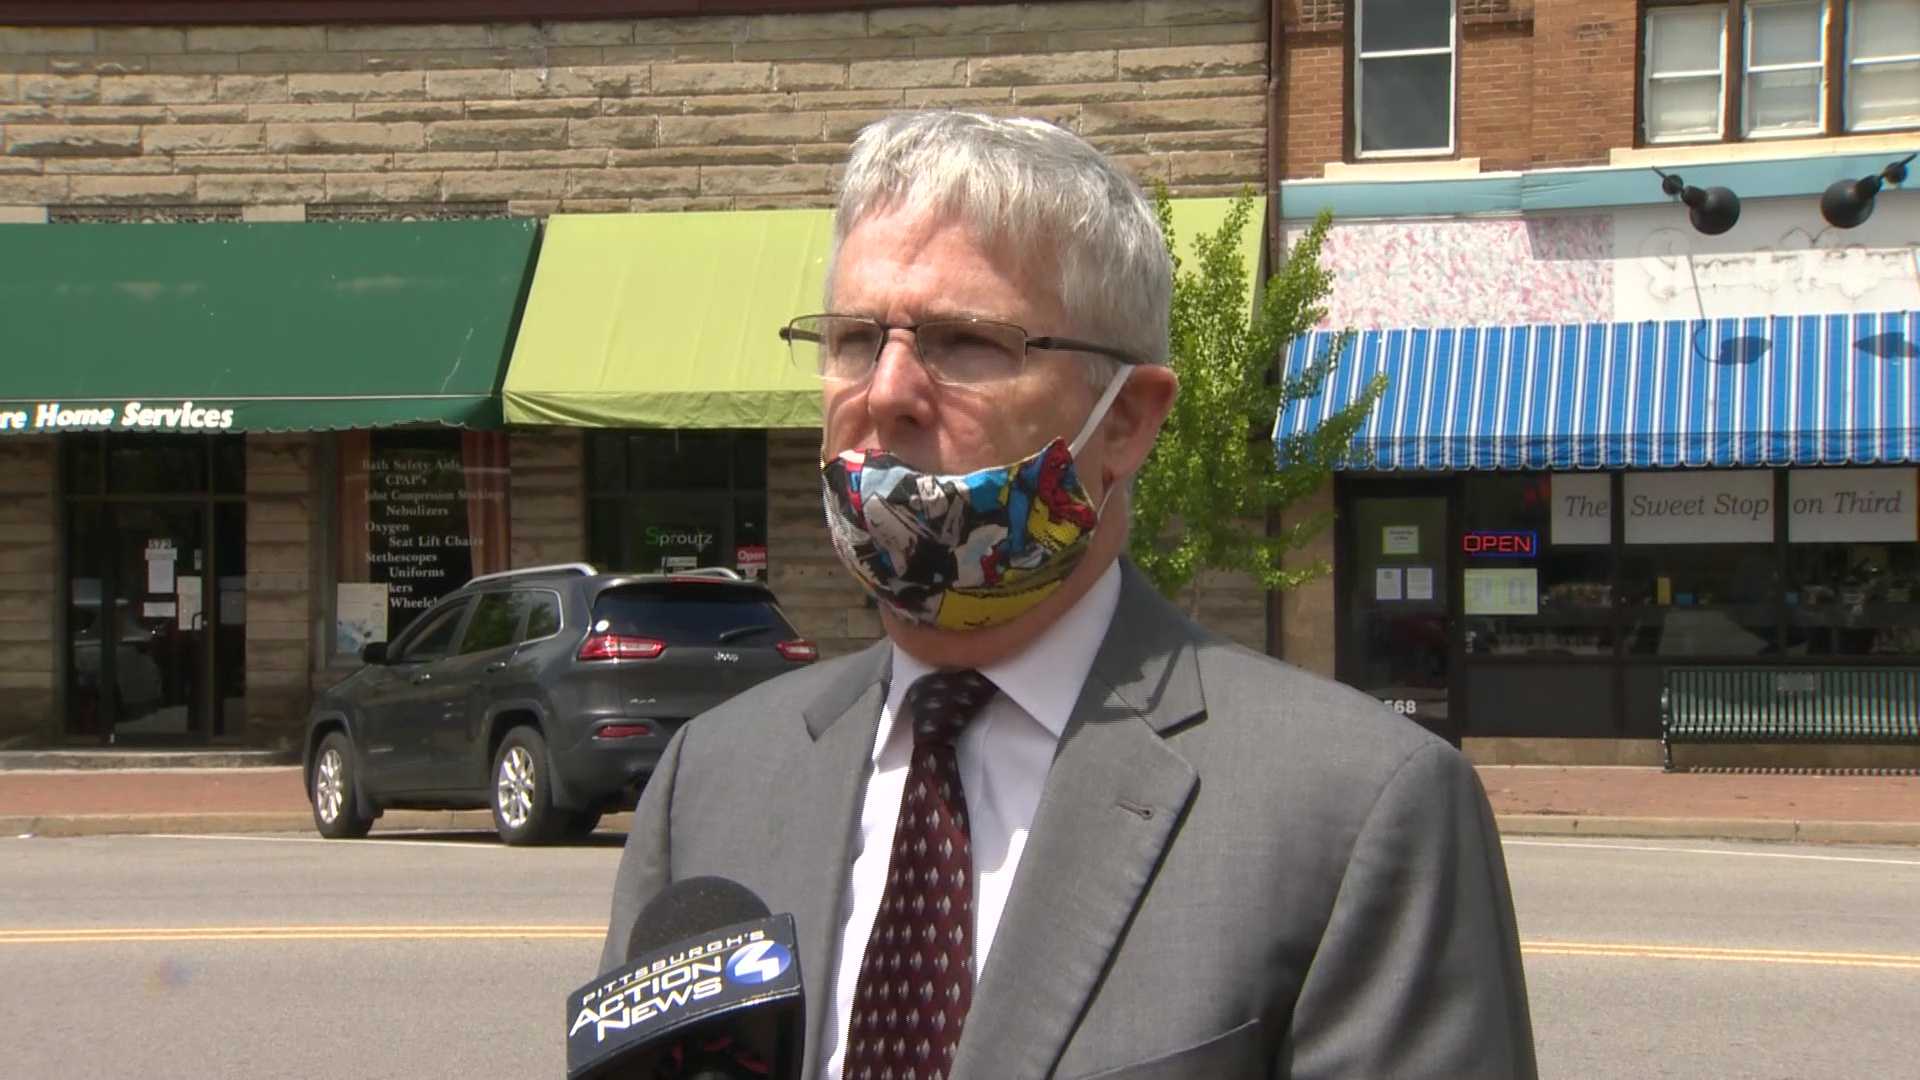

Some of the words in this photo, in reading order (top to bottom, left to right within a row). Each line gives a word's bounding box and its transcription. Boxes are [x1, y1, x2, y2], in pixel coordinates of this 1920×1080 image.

[35, 403, 114, 428] Home
[122, 402, 234, 428] Services
[386, 505, 449, 516] Nebulizers
[1565, 496, 1607, 518] The
[1631, 495, 1704, 517] Sweet
[1713, 492, 1769, 521] Stop
[1792, 496, 1824, 515] on
[1834, 490, 1902, 514] Third
[365, 522, 409, 535] Oxygen
[389, 536, 413, 547] Seat
[418, 536, 440, 547] Lift
[1463, 535, 1531, 553] OPEN
[738, 550, 766, 562] Open
[389, 567, 445, 578] Uniforms
[1384, 699, 1416, 714] 68
[583, 929, 765, 1006] PITTSBURGH'S
[734, 939, 781, 982] 4
[569, 955, 722, 1037] ACTION
[597, 976, 722, 1042] NEWS
